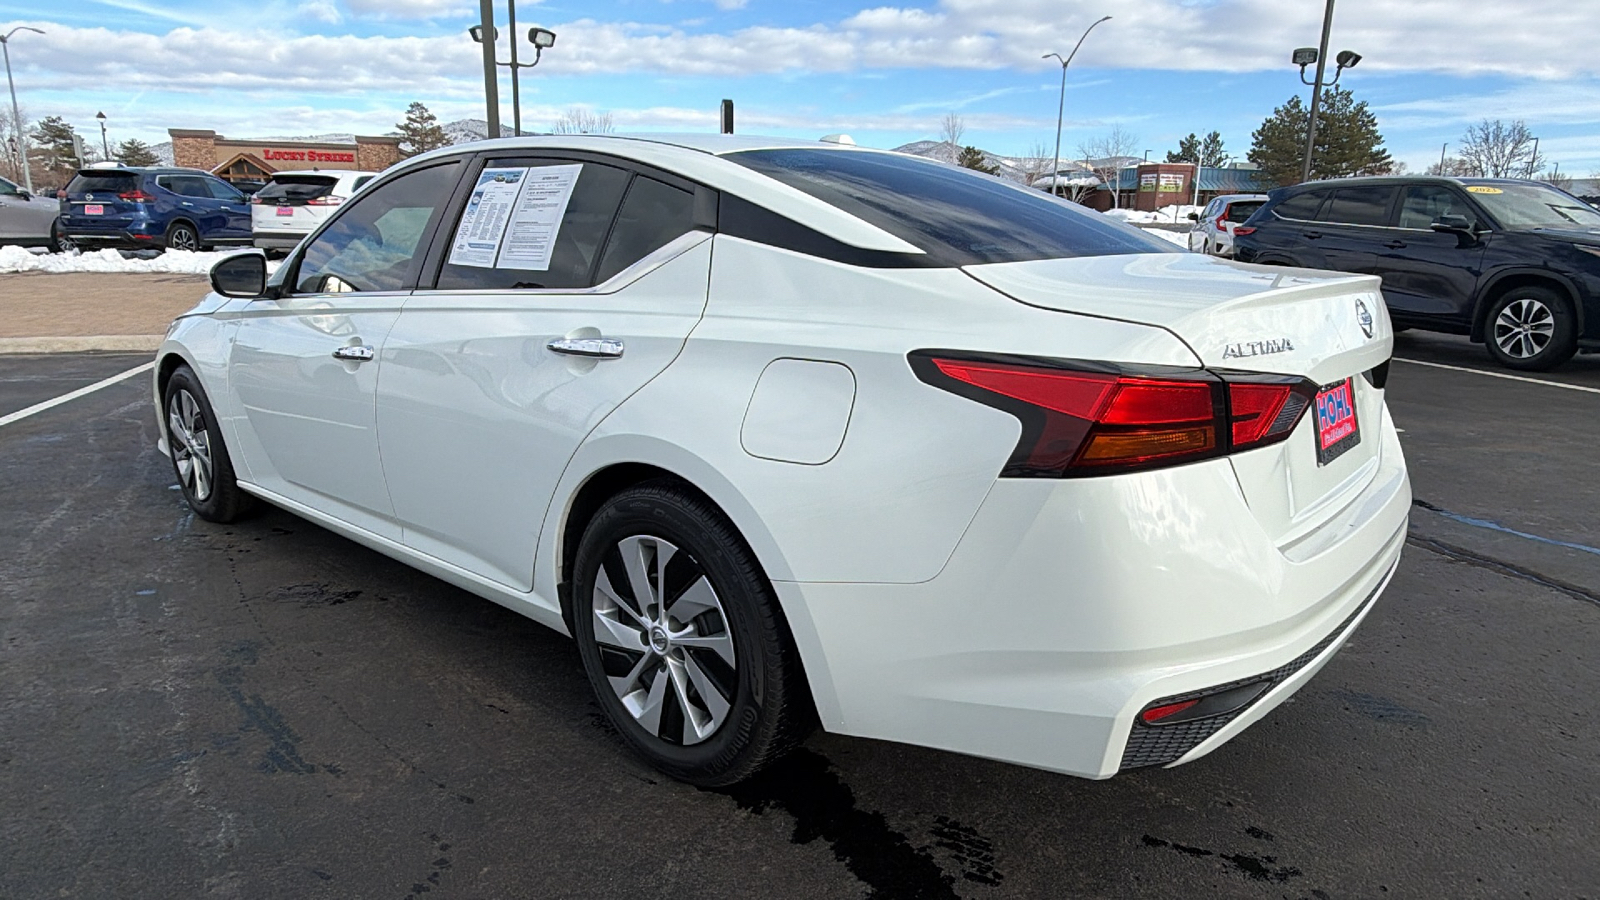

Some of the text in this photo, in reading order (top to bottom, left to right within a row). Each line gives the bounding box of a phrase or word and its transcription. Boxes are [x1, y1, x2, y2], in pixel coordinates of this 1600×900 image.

[263, 148, 354, 162] LUCKY STRIKE
[1222, 338, 1295, 360] ALTIMA
[1317, 386, 1352, 432] HOHL
